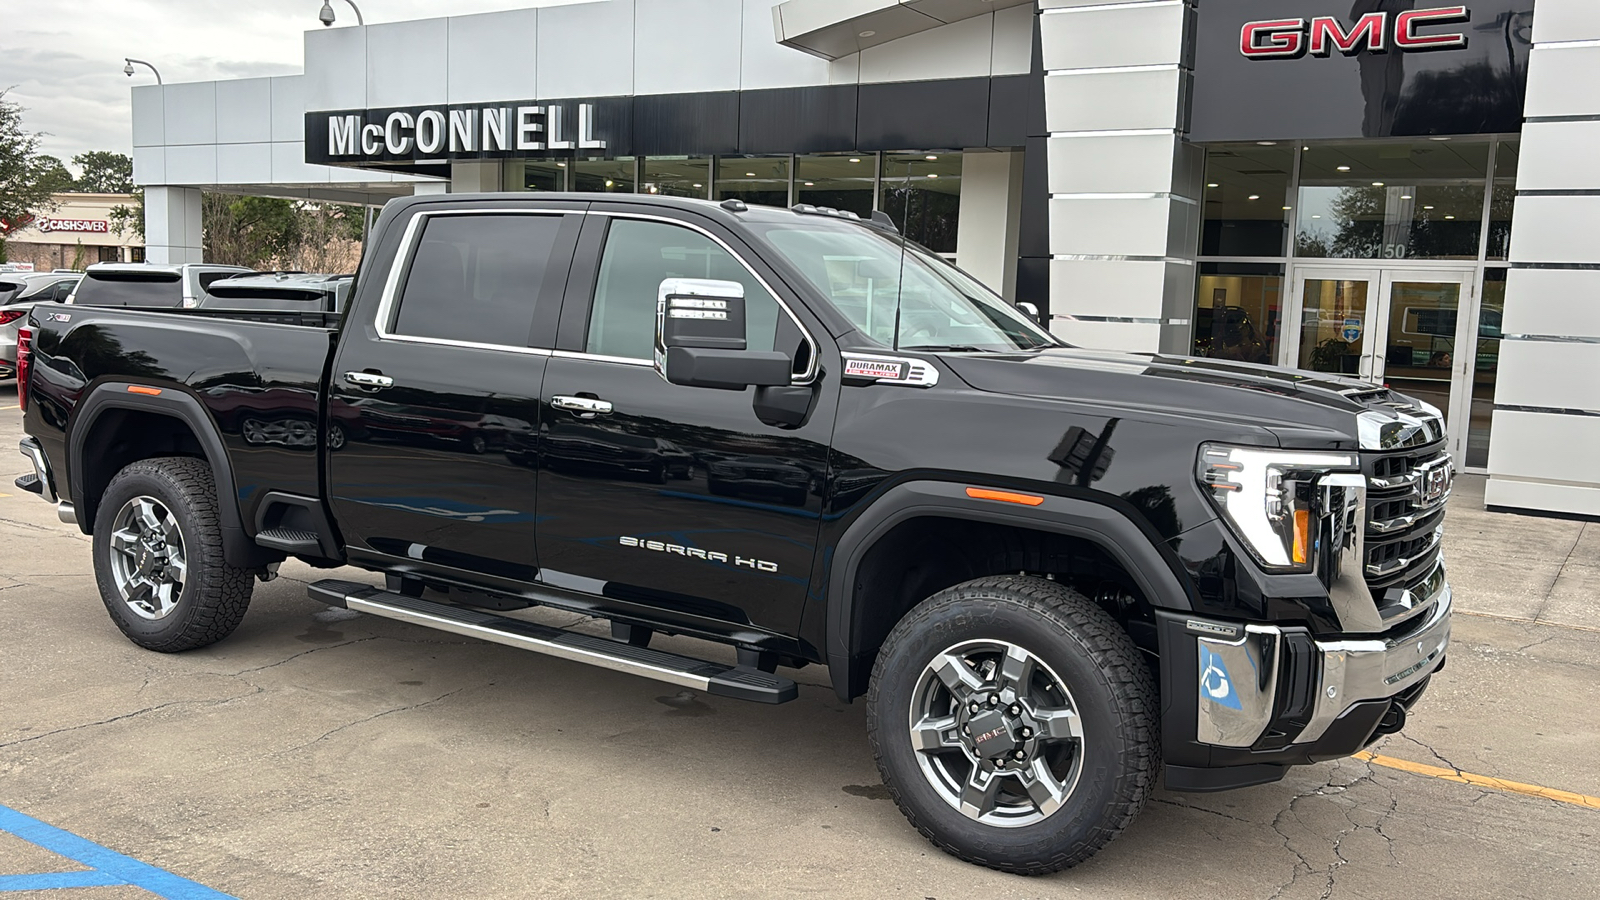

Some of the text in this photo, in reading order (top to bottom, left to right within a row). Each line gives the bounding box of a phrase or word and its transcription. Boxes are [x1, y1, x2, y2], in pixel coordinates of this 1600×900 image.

[1240, 5, 1467, 57] GMC
[328, 103, 607, 156] McCONNELL
[50, 220, 106, 231] CASHSAVER
[1363, 243, 1406, 258] 3150
[850, 361, 897, 372] DURAMAX
[619, 536, 778, 573] SIERRA HD
[975, 725, 1007, 744] GMC
